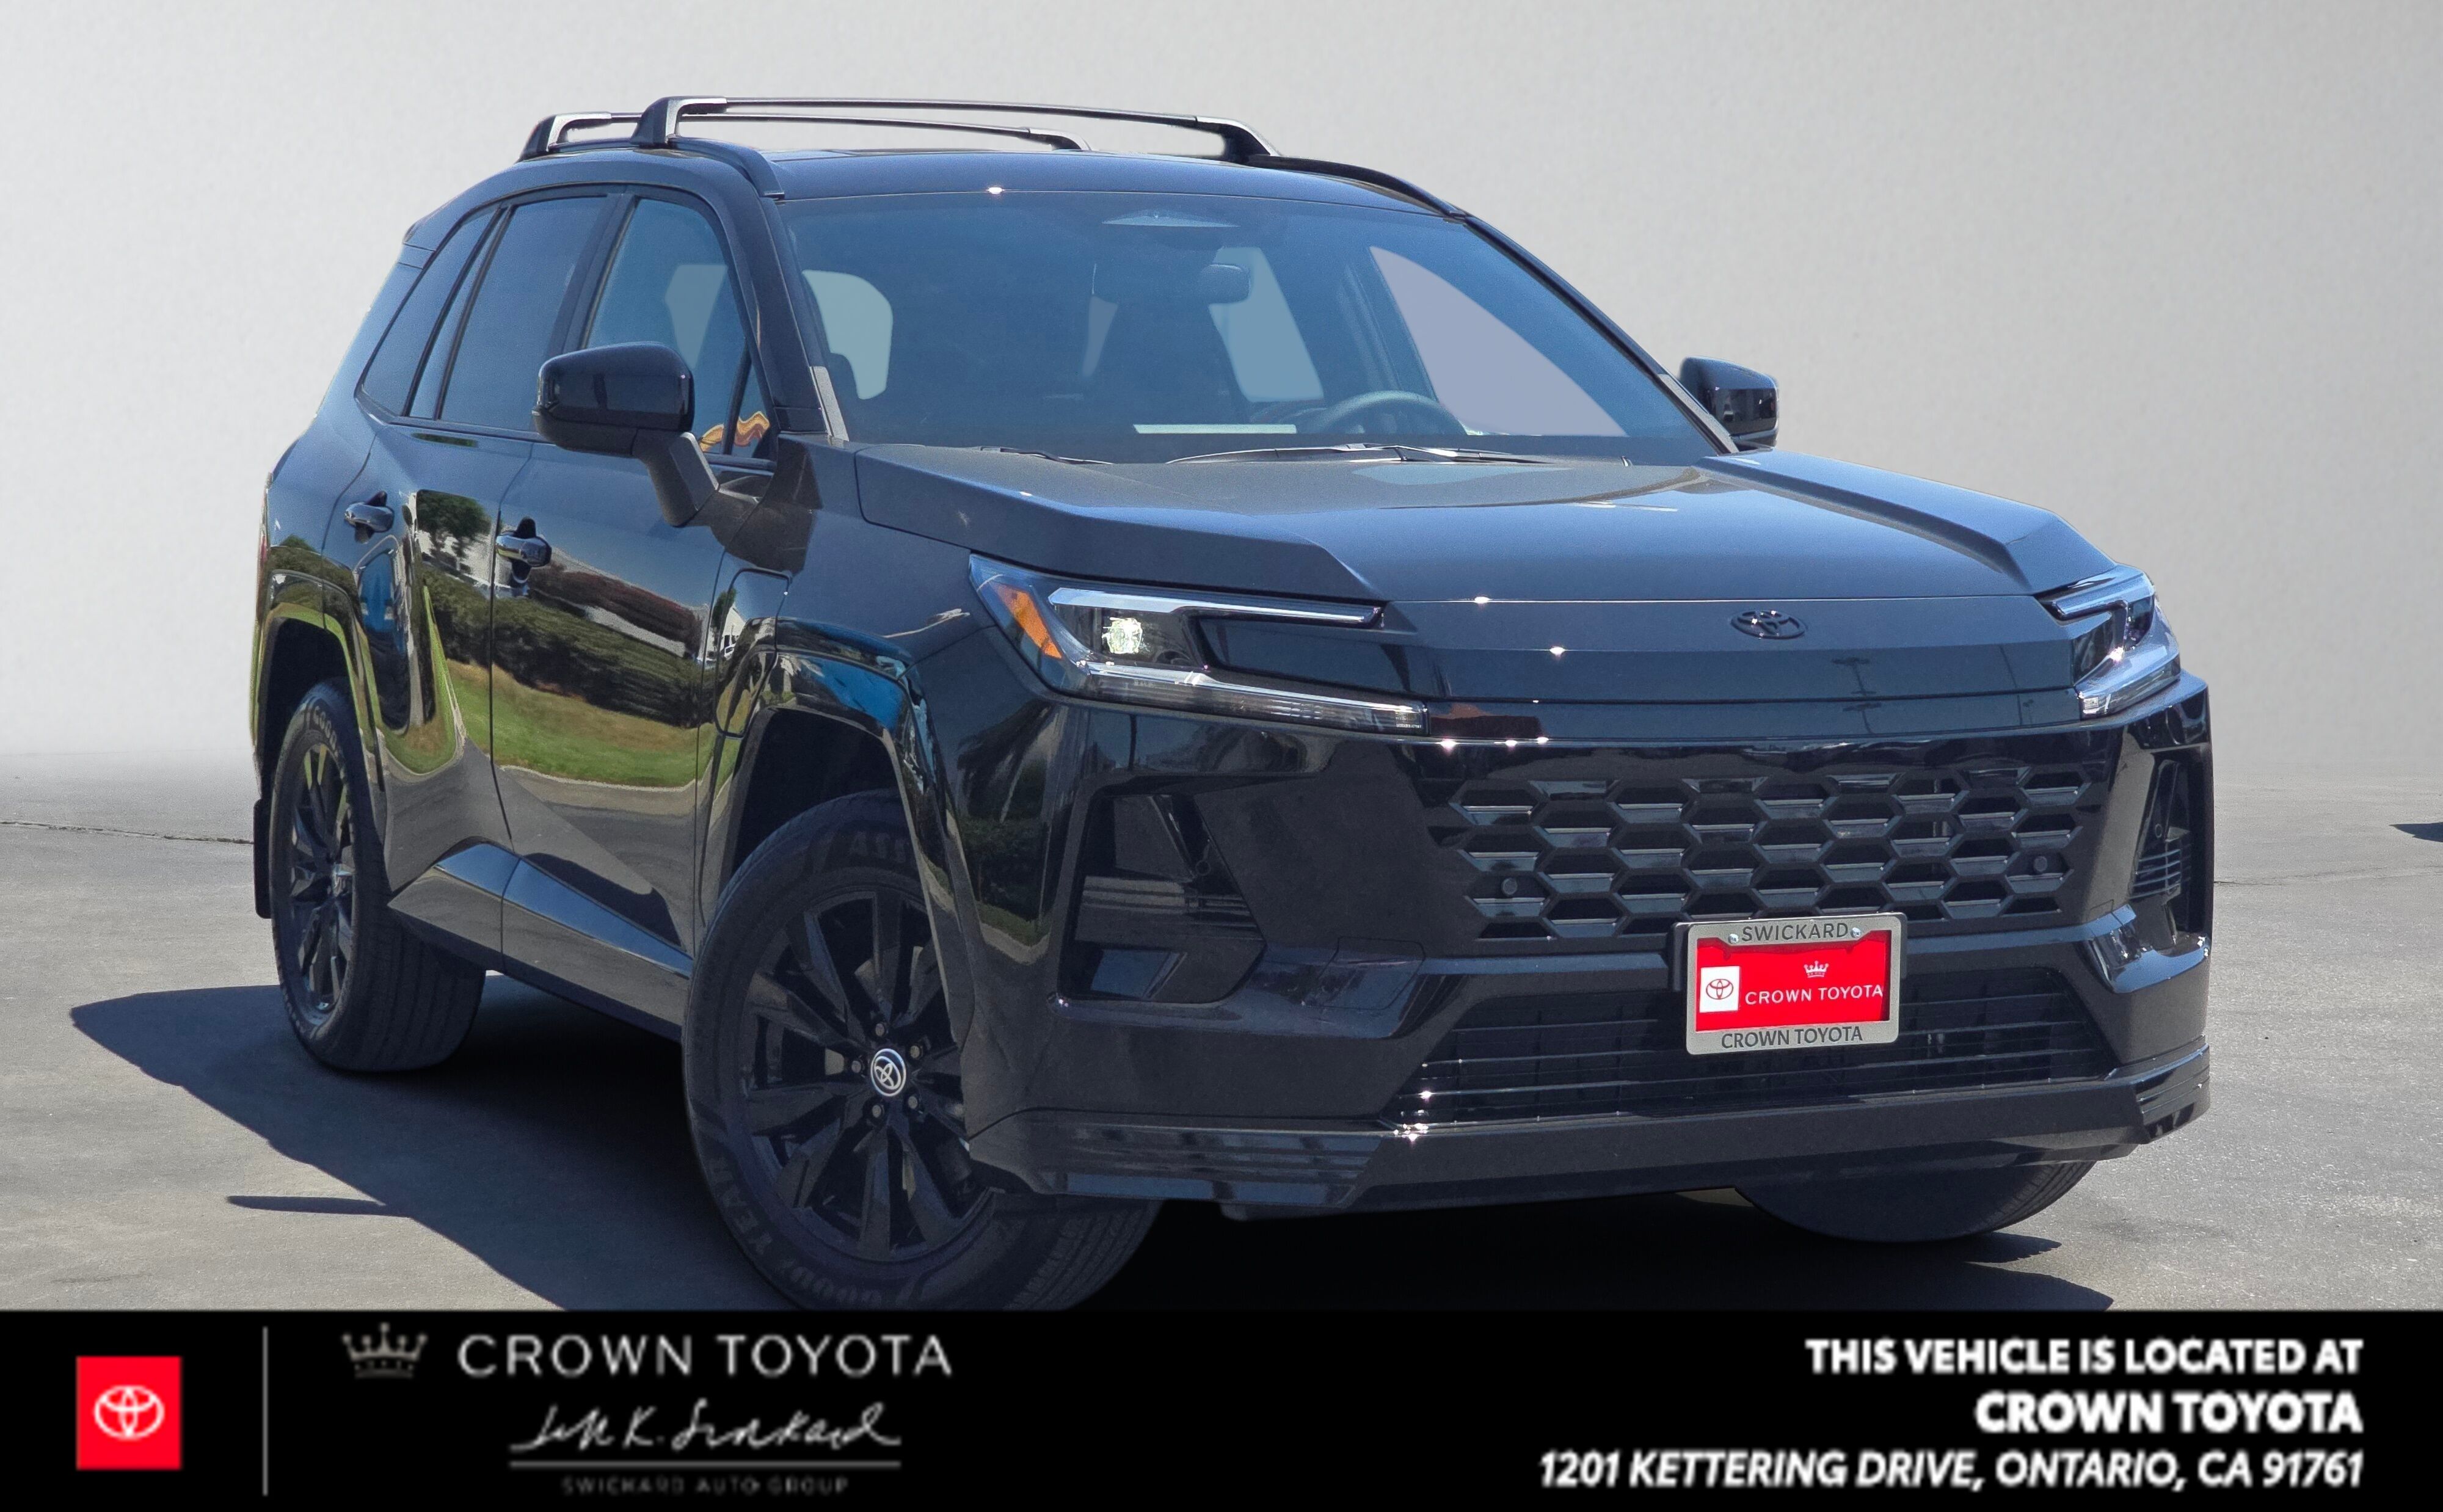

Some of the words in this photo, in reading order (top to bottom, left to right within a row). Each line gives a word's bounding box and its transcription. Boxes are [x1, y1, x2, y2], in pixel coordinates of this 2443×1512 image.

[1742, 923, 1849, 942] SWICKARD
[1745, 988, 1812, 1006] CROWN
[1818, 984, 1884, 1001] TOYOTA
[1721, 1030, 1789, 1049] CROWN
[1794, 1026, 1863, 1044] TOYOTA
